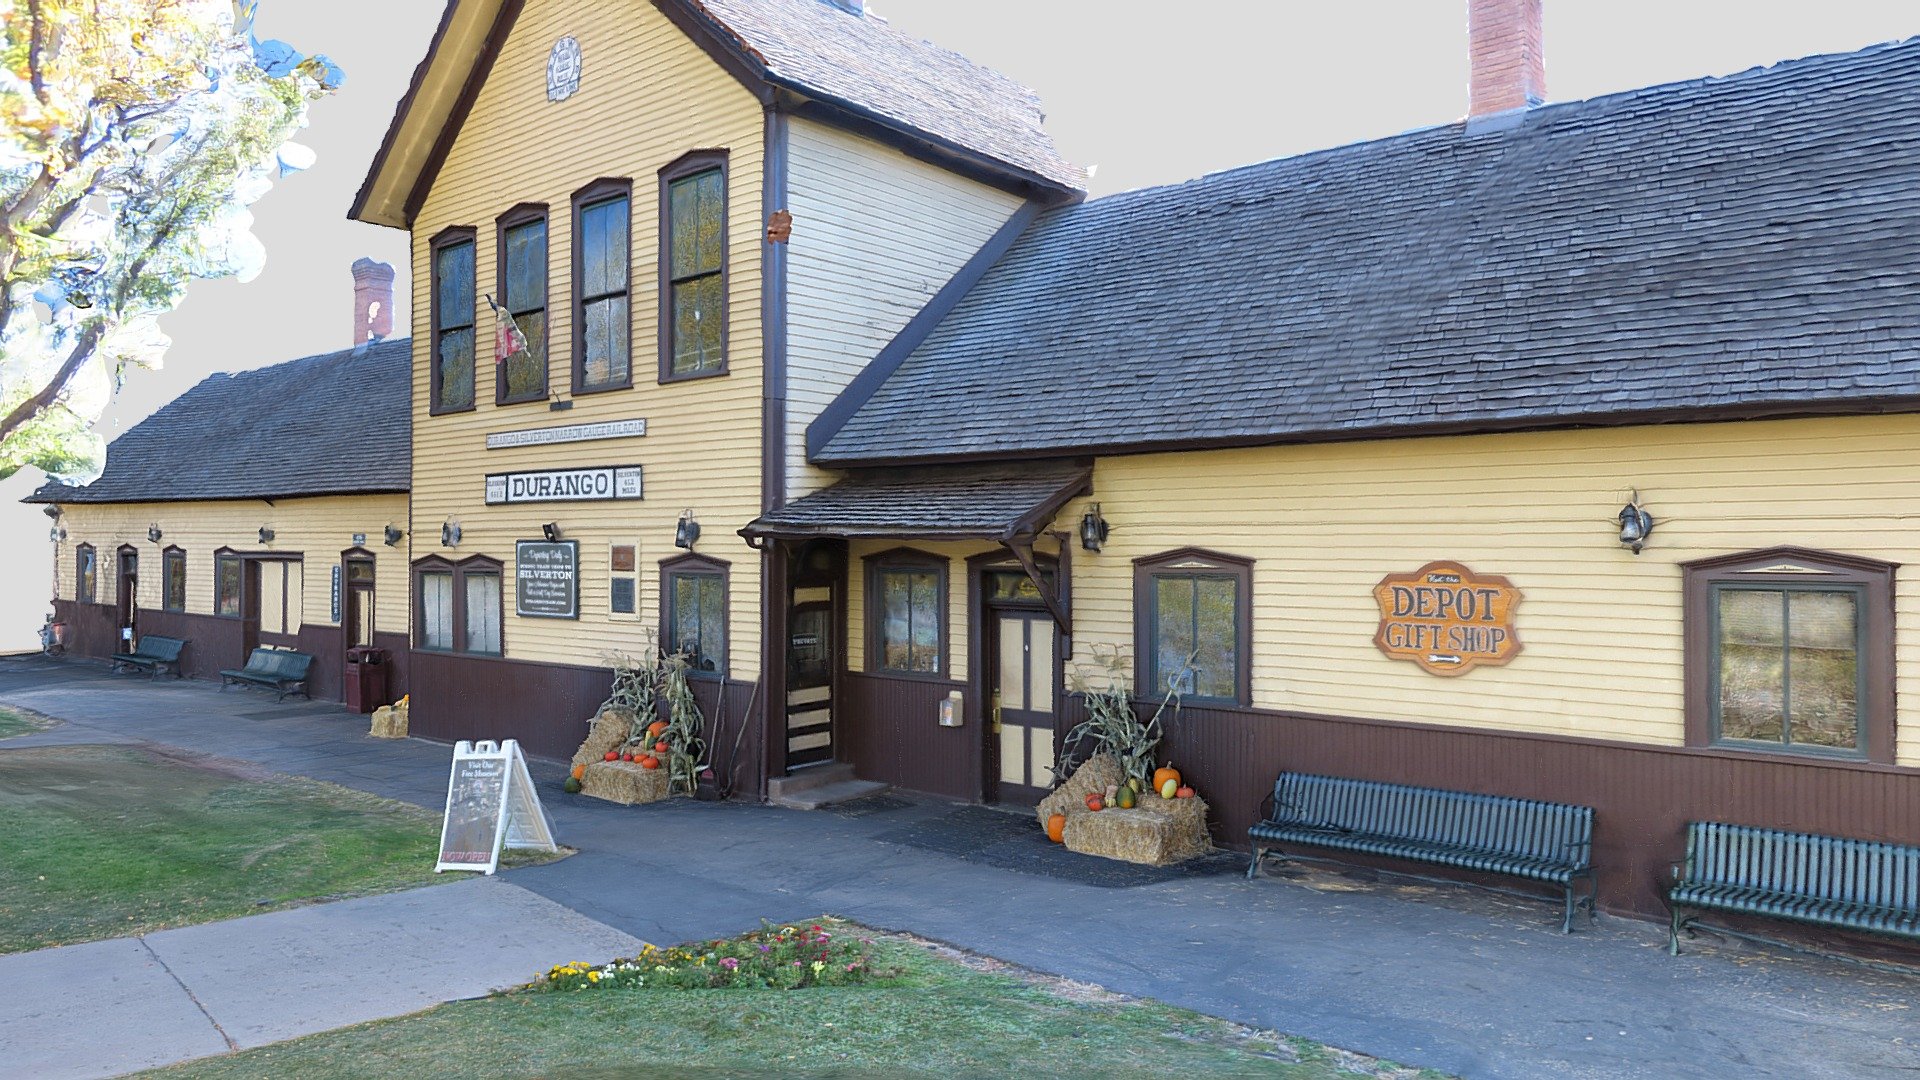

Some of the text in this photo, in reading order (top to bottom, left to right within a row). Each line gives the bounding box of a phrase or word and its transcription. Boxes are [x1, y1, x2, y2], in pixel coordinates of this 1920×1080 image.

[487, 434, 515, 446] DURANGO
[520, 430, 555, 443] SILVERTON
[556, 428, 583, 440] NARROW
[583, 426, 606, 438] GAUGE
[607, 422, 644, 435] RAILROAD
[512, 473, 608, 498] DURANGO
[519, 570, 573, 580] SILVERTON
[1391, 586, 1501, 621] DEPOT
[1385, 622, 1506, 653] GIFT SHOP
[441, 851, 465, 862] NOW
